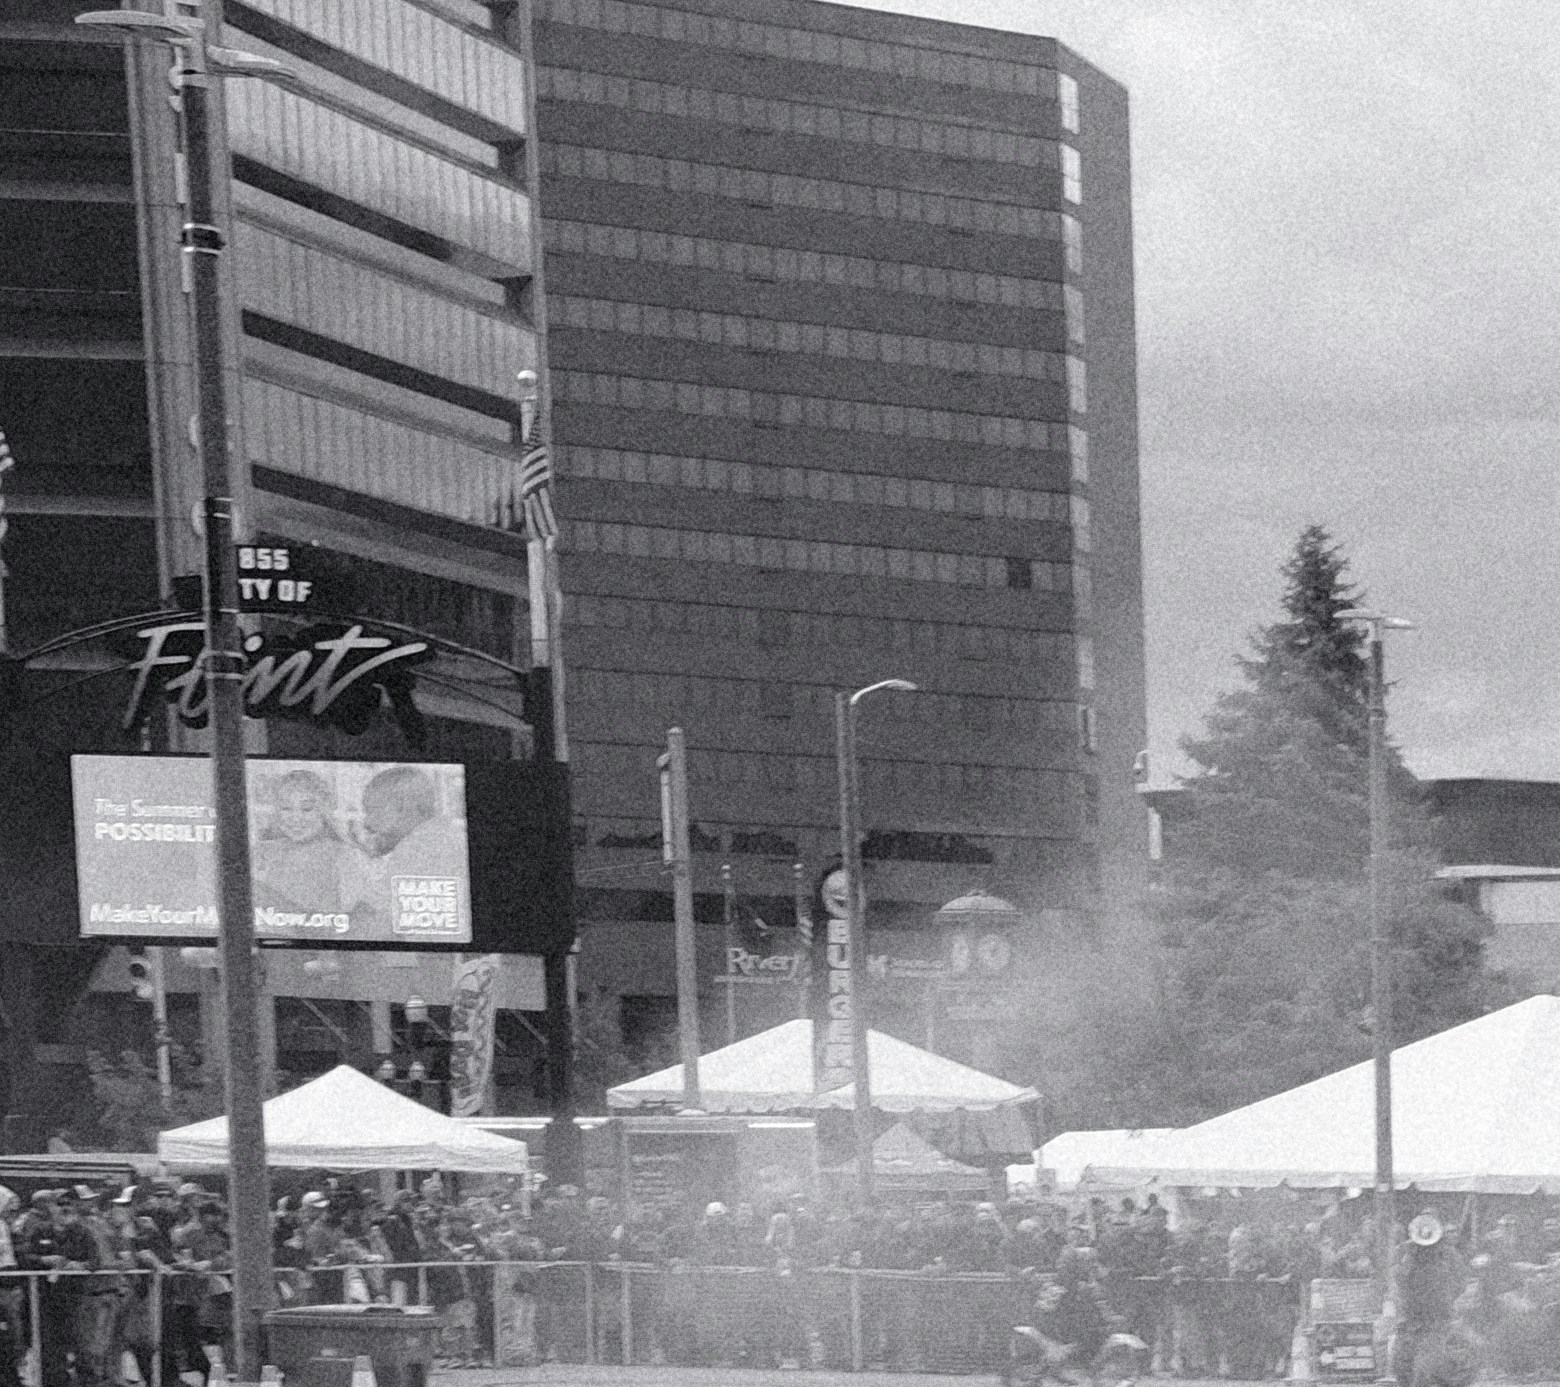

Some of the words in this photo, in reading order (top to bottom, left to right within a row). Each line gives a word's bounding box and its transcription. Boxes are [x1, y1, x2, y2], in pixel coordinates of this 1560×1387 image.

[238, 547, 290, 571] 855
[237, 578, 273, 600] TY
[277, 579, 313, 602] OF
[95, 822, 217, 843] POSSIBILIT
[398, 879, 458, 896] MAKE
[400, 895, 458, 912] YOUR
[398, 911, 458, 929] MOVE
